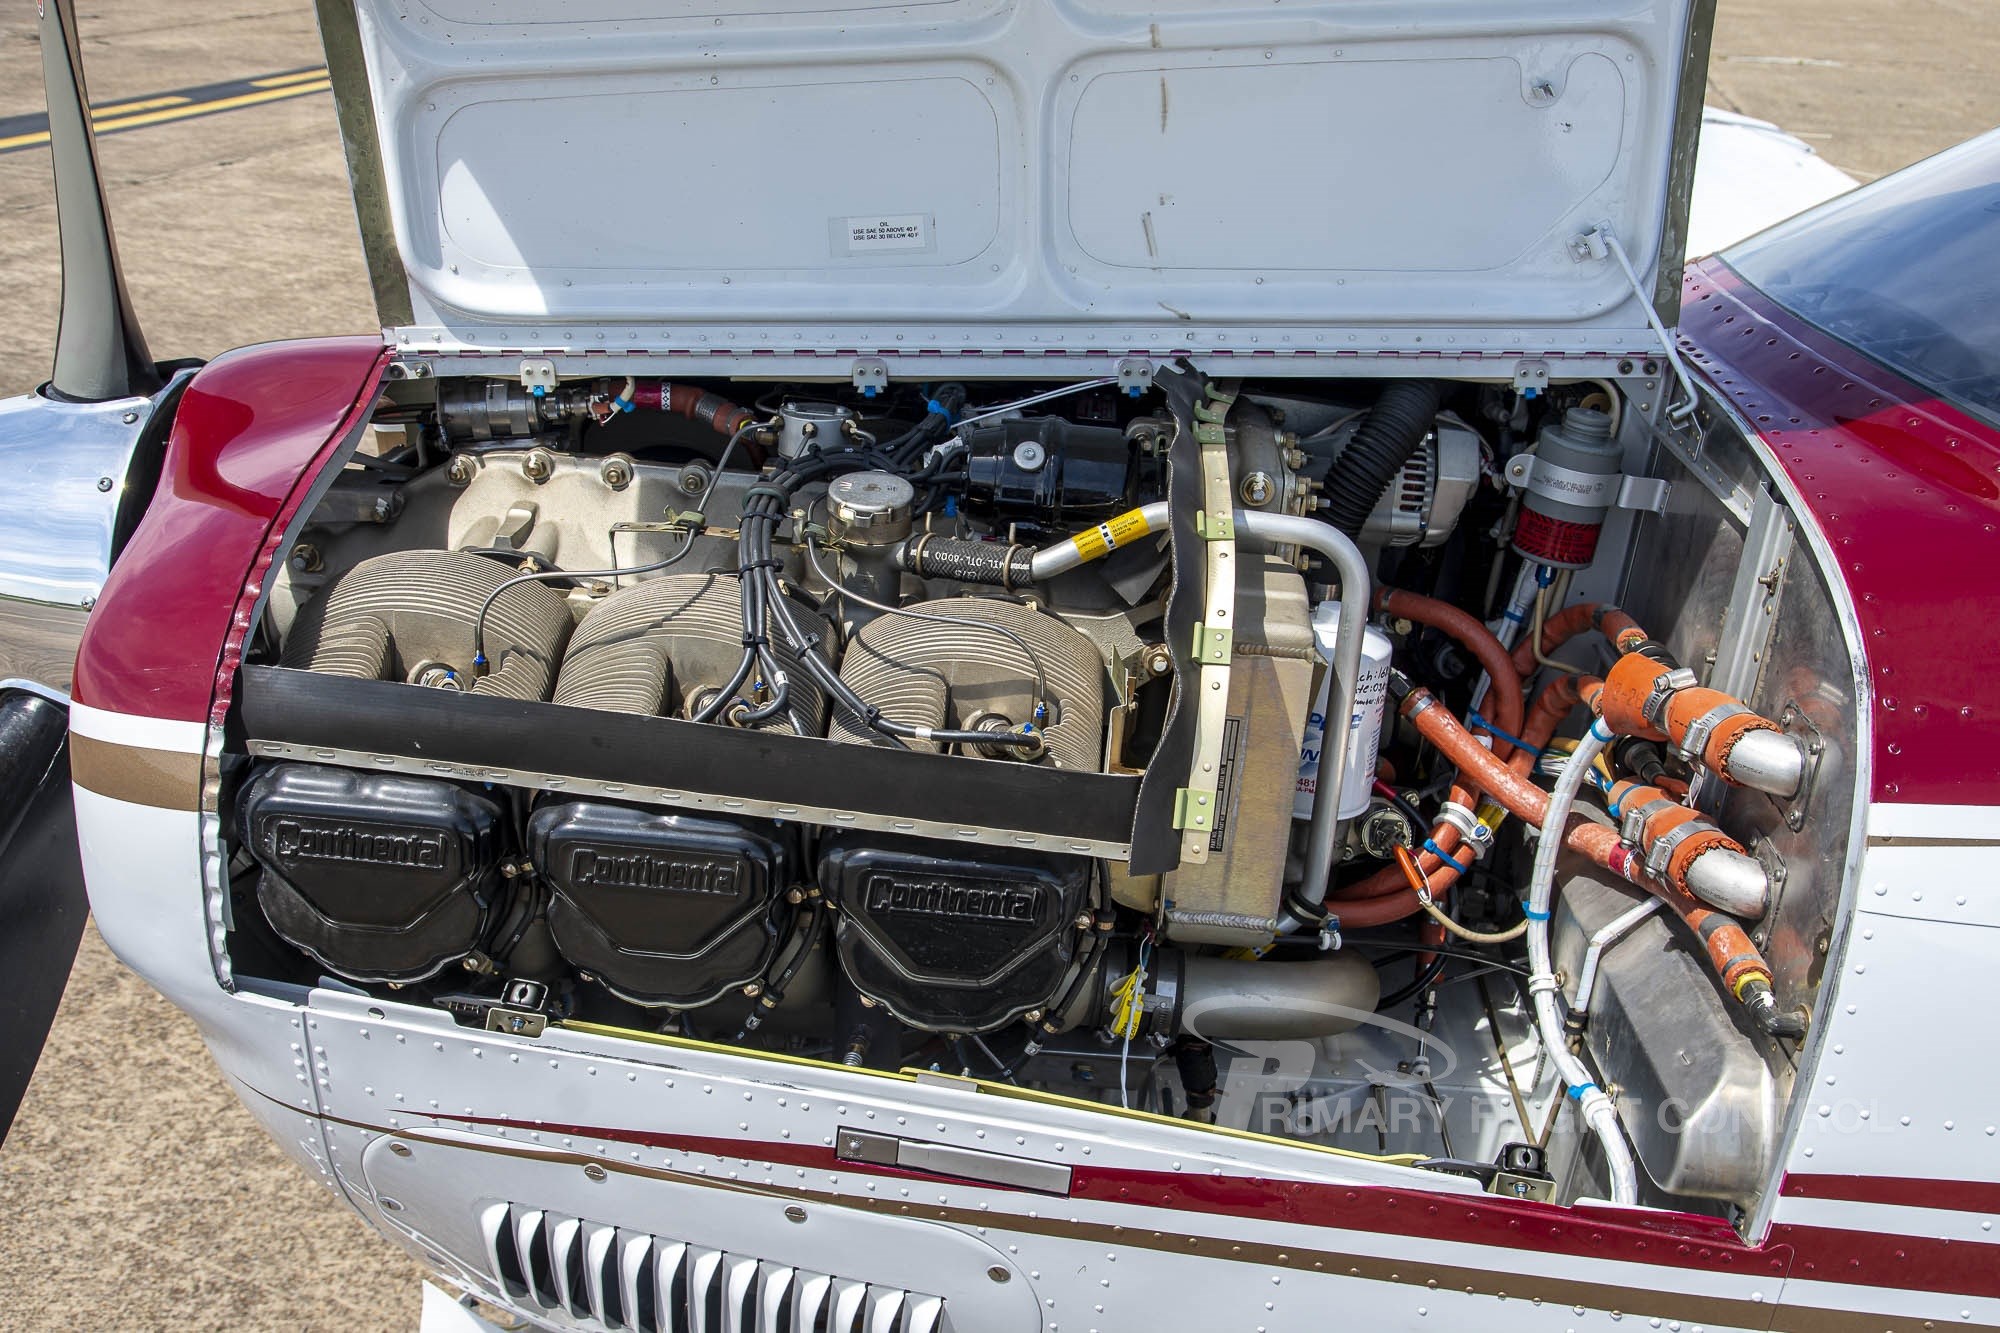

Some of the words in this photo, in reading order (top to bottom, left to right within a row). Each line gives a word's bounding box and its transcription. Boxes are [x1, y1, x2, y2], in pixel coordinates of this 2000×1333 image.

[275, 820, 447, 870] Continental
[573, 847, 743, 897] Continental
[867, 868, 1042, 924] Continental
